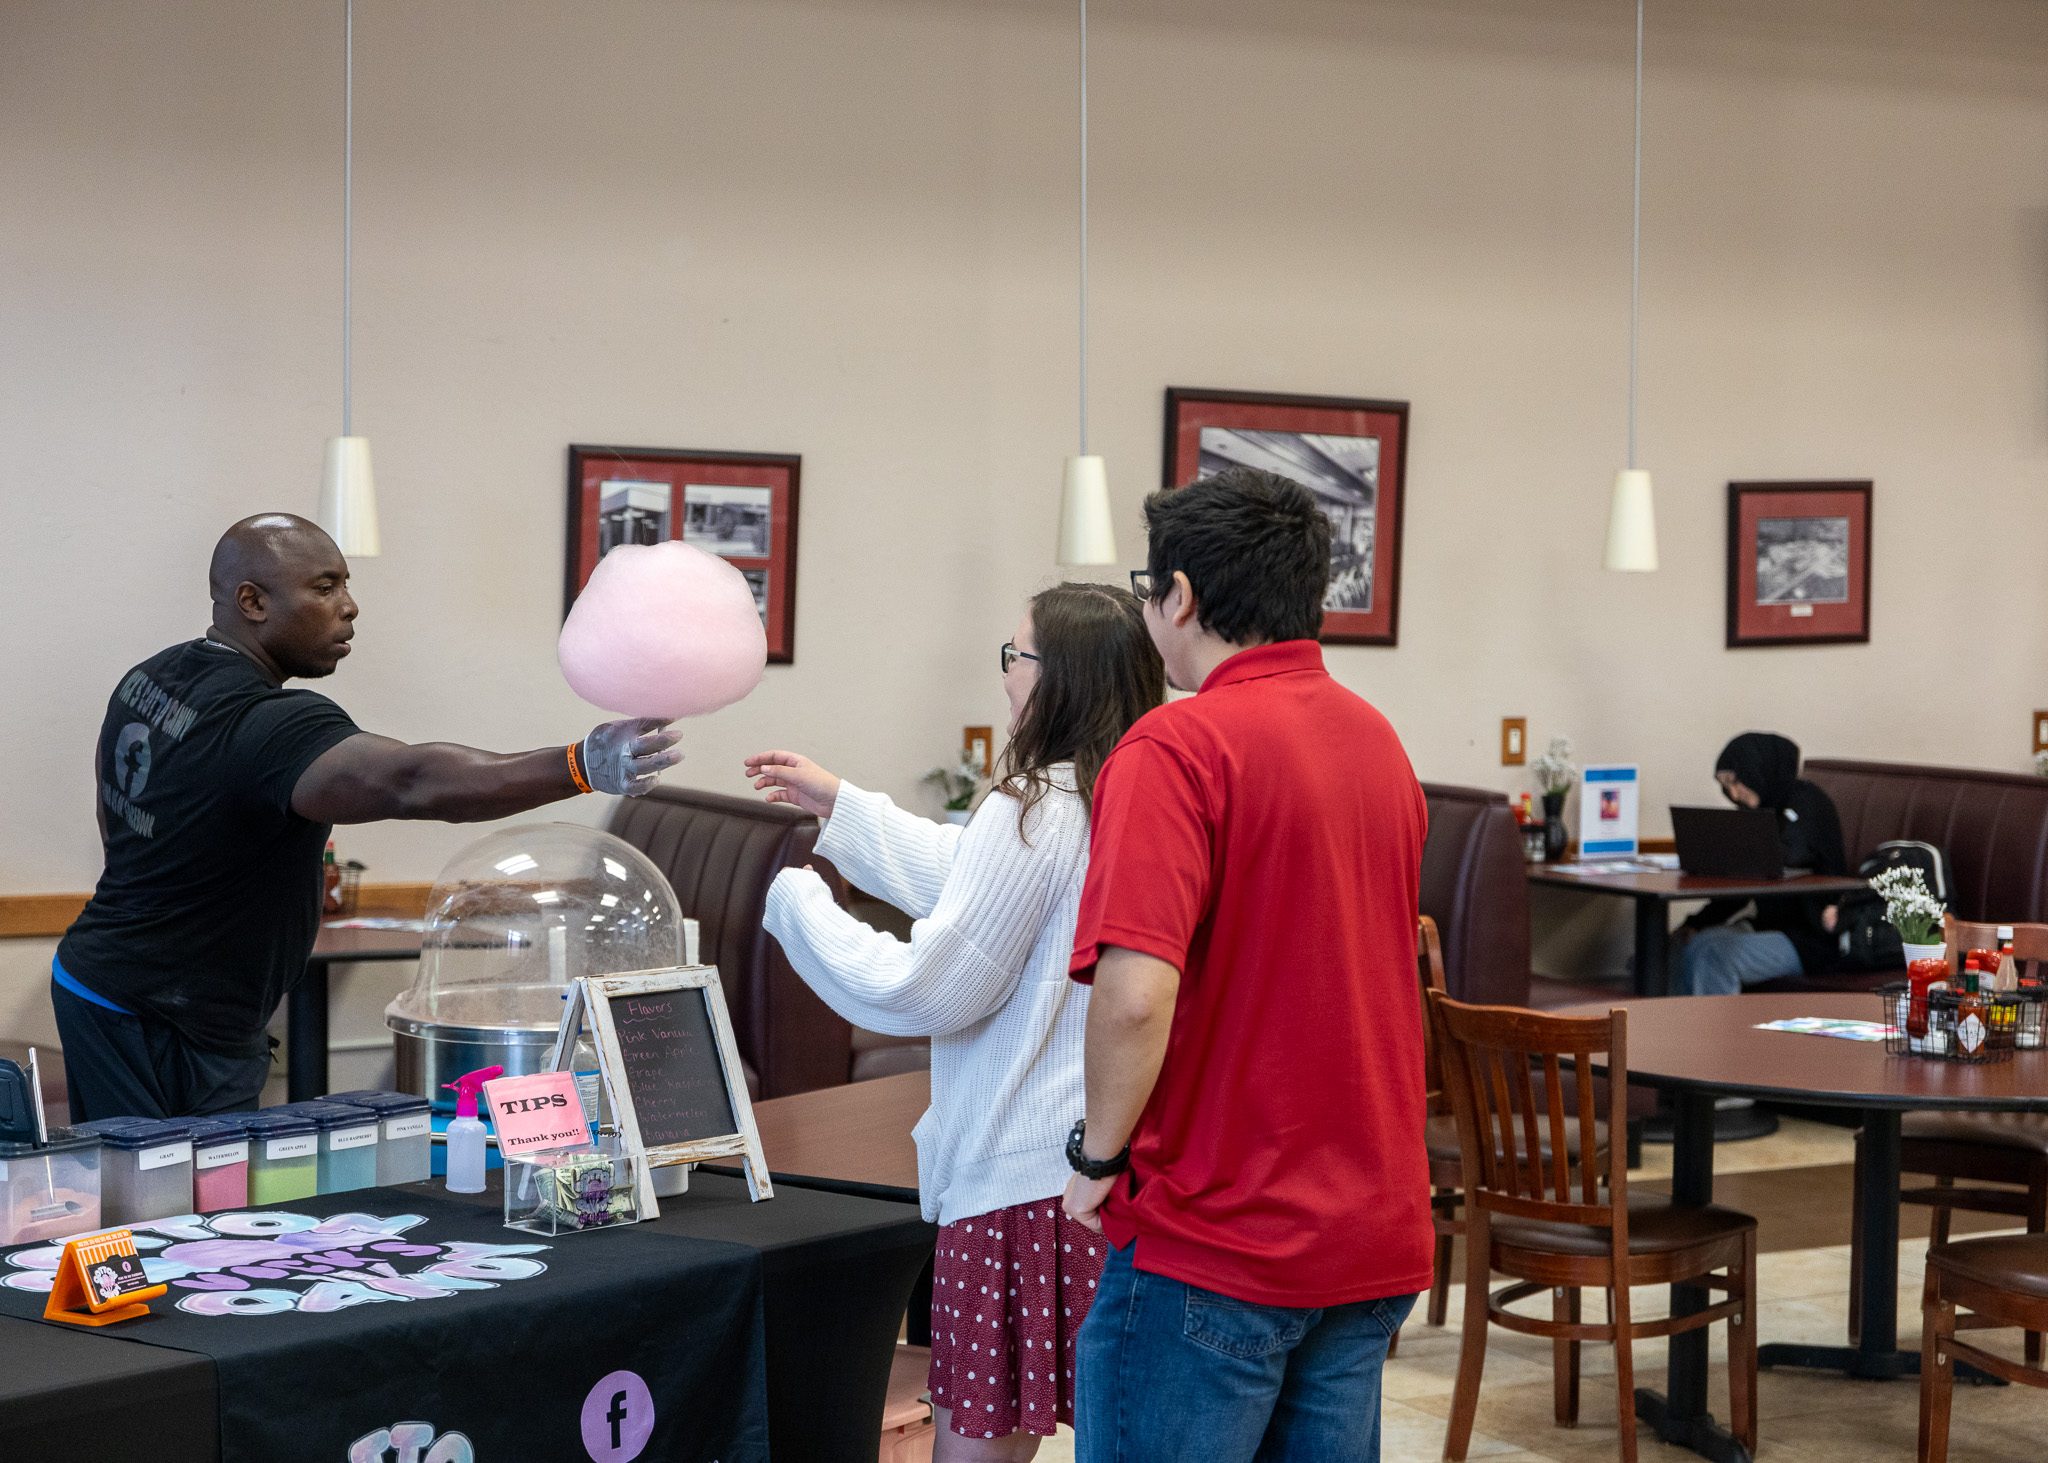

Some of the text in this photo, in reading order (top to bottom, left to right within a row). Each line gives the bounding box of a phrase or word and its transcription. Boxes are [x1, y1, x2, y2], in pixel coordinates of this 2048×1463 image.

[627, 1001, 672, 1015] Flavors
[616, 1029, 647, 1045] Pink
[623, 1049, 660, 1062] Green
[500, 1094, 567, 1115] TIPS
[349, 1134, 372, 1142] RASPBERRY
[508, 1128, 580, 1146] Thank you!!
[159, 1152, 175, 1160] GRAPE
[208, 1151, 240, 1161] WATERMELON
